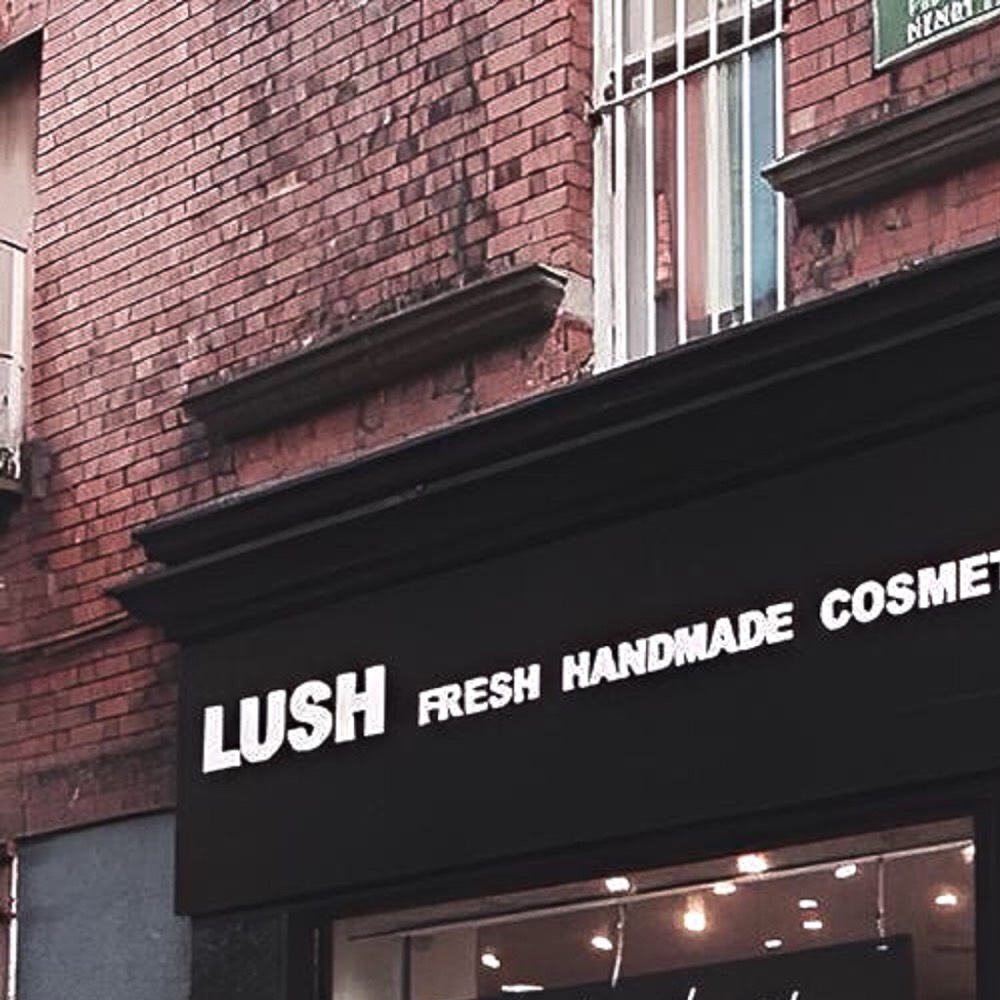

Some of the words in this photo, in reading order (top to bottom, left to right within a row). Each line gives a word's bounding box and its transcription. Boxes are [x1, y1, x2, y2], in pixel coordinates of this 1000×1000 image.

[203, 665, 386, 774] LUSH
[418, 664, 541, 727] FRESH
[562, 602, 794, 692] HANDMADE
